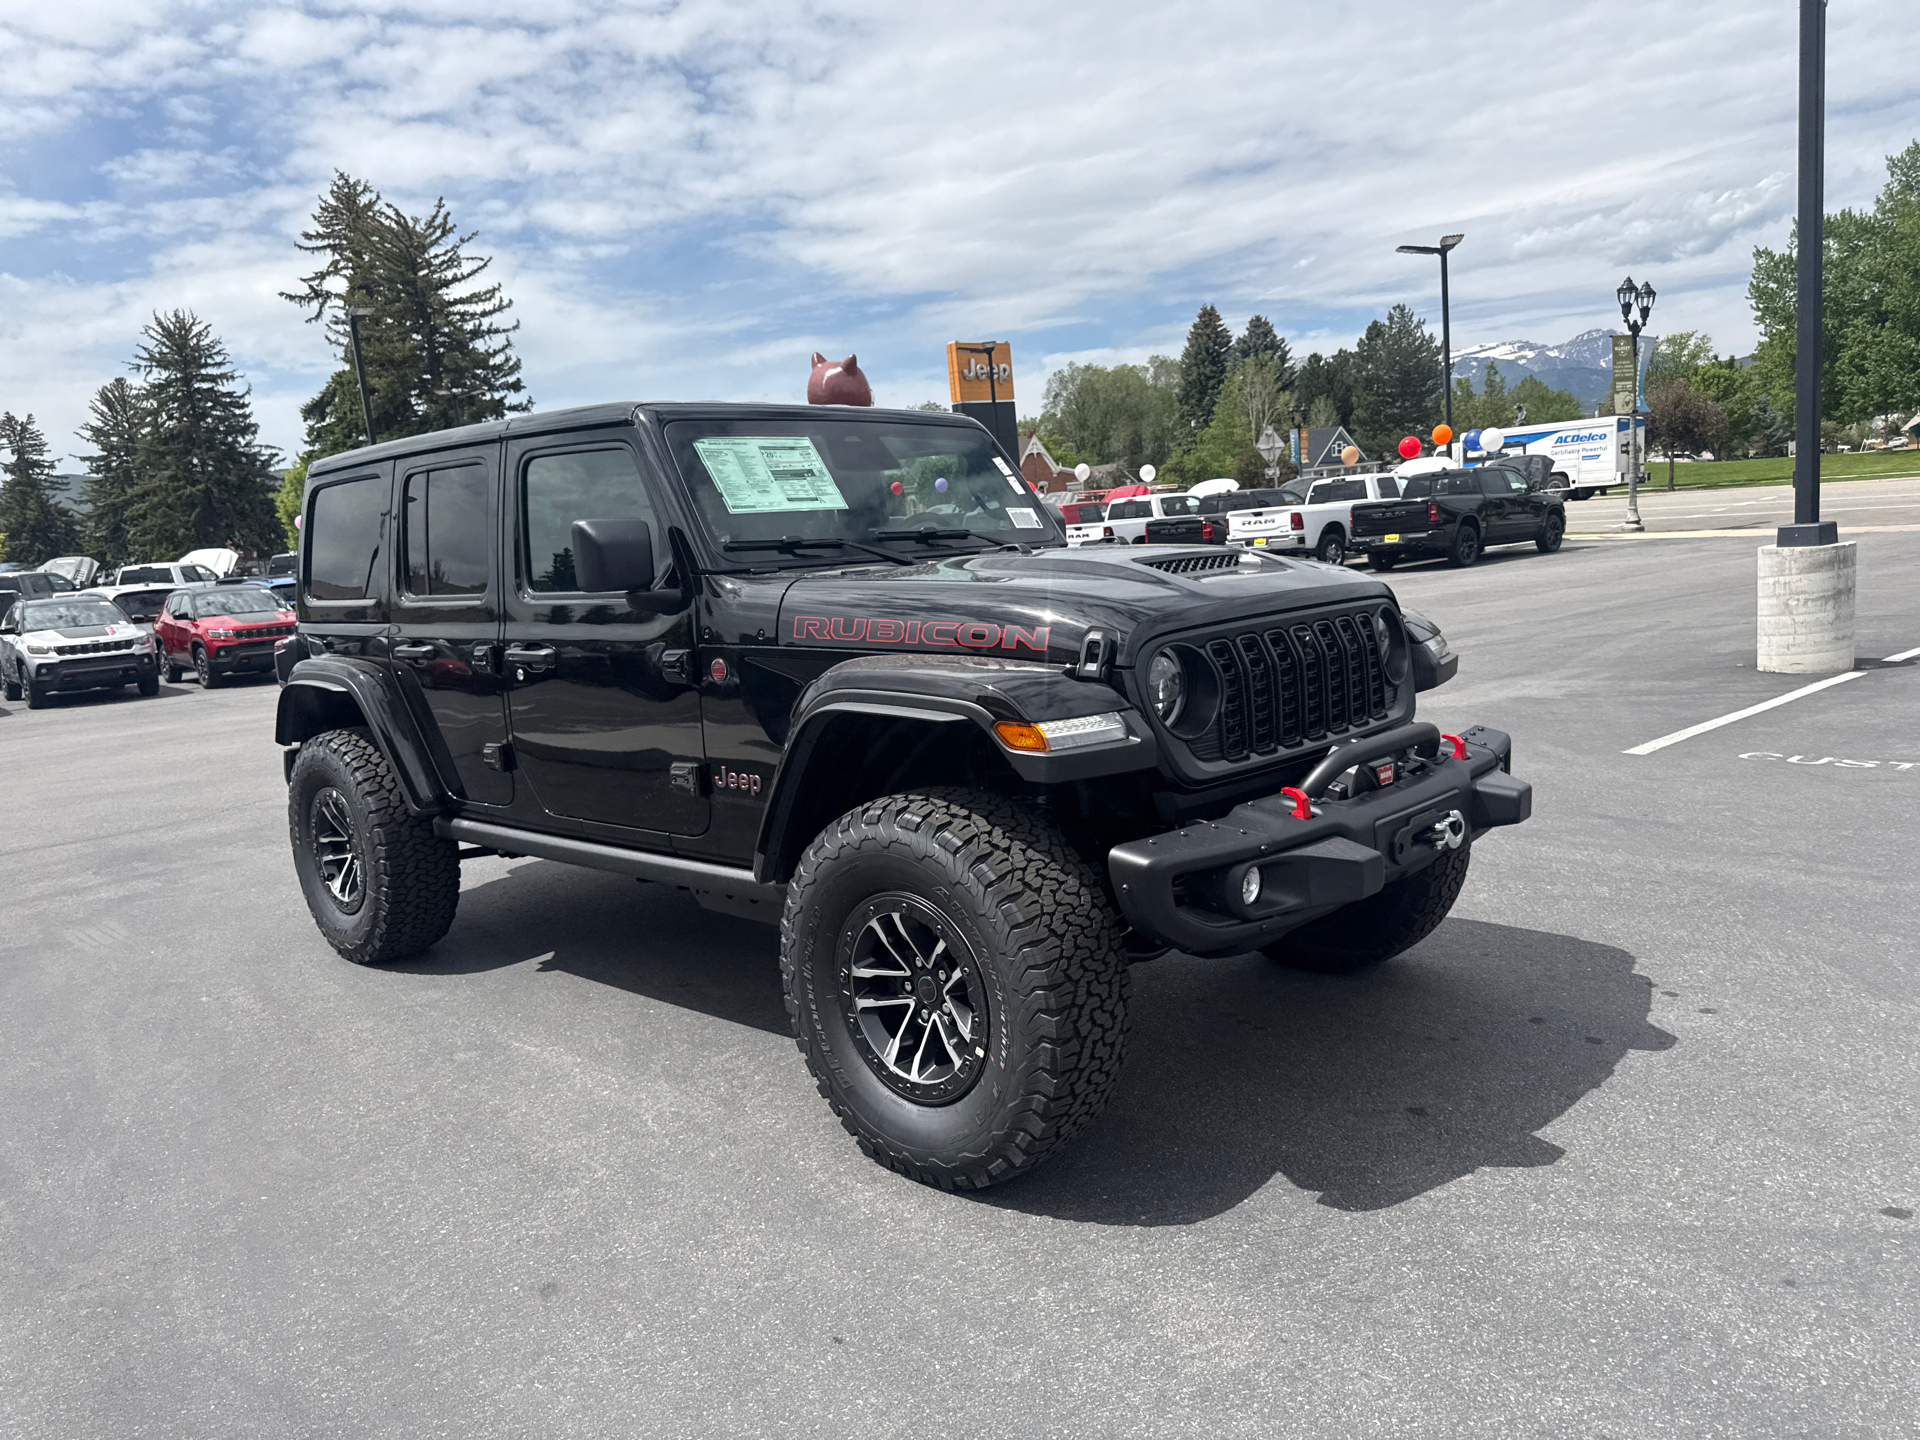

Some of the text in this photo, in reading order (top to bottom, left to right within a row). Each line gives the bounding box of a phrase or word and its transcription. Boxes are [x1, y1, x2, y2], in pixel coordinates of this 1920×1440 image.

[962, 358, 1010, 384] Jeep
[1554, 433, 1608, 444] ACDelco
[1551, 445, 1608, 456] Certifiably Powerful
[1241, 518, 1276, 527] RAM
[793, 615, 1052, 651] RUBICON
[714, 765, 762, 796] Jeep
